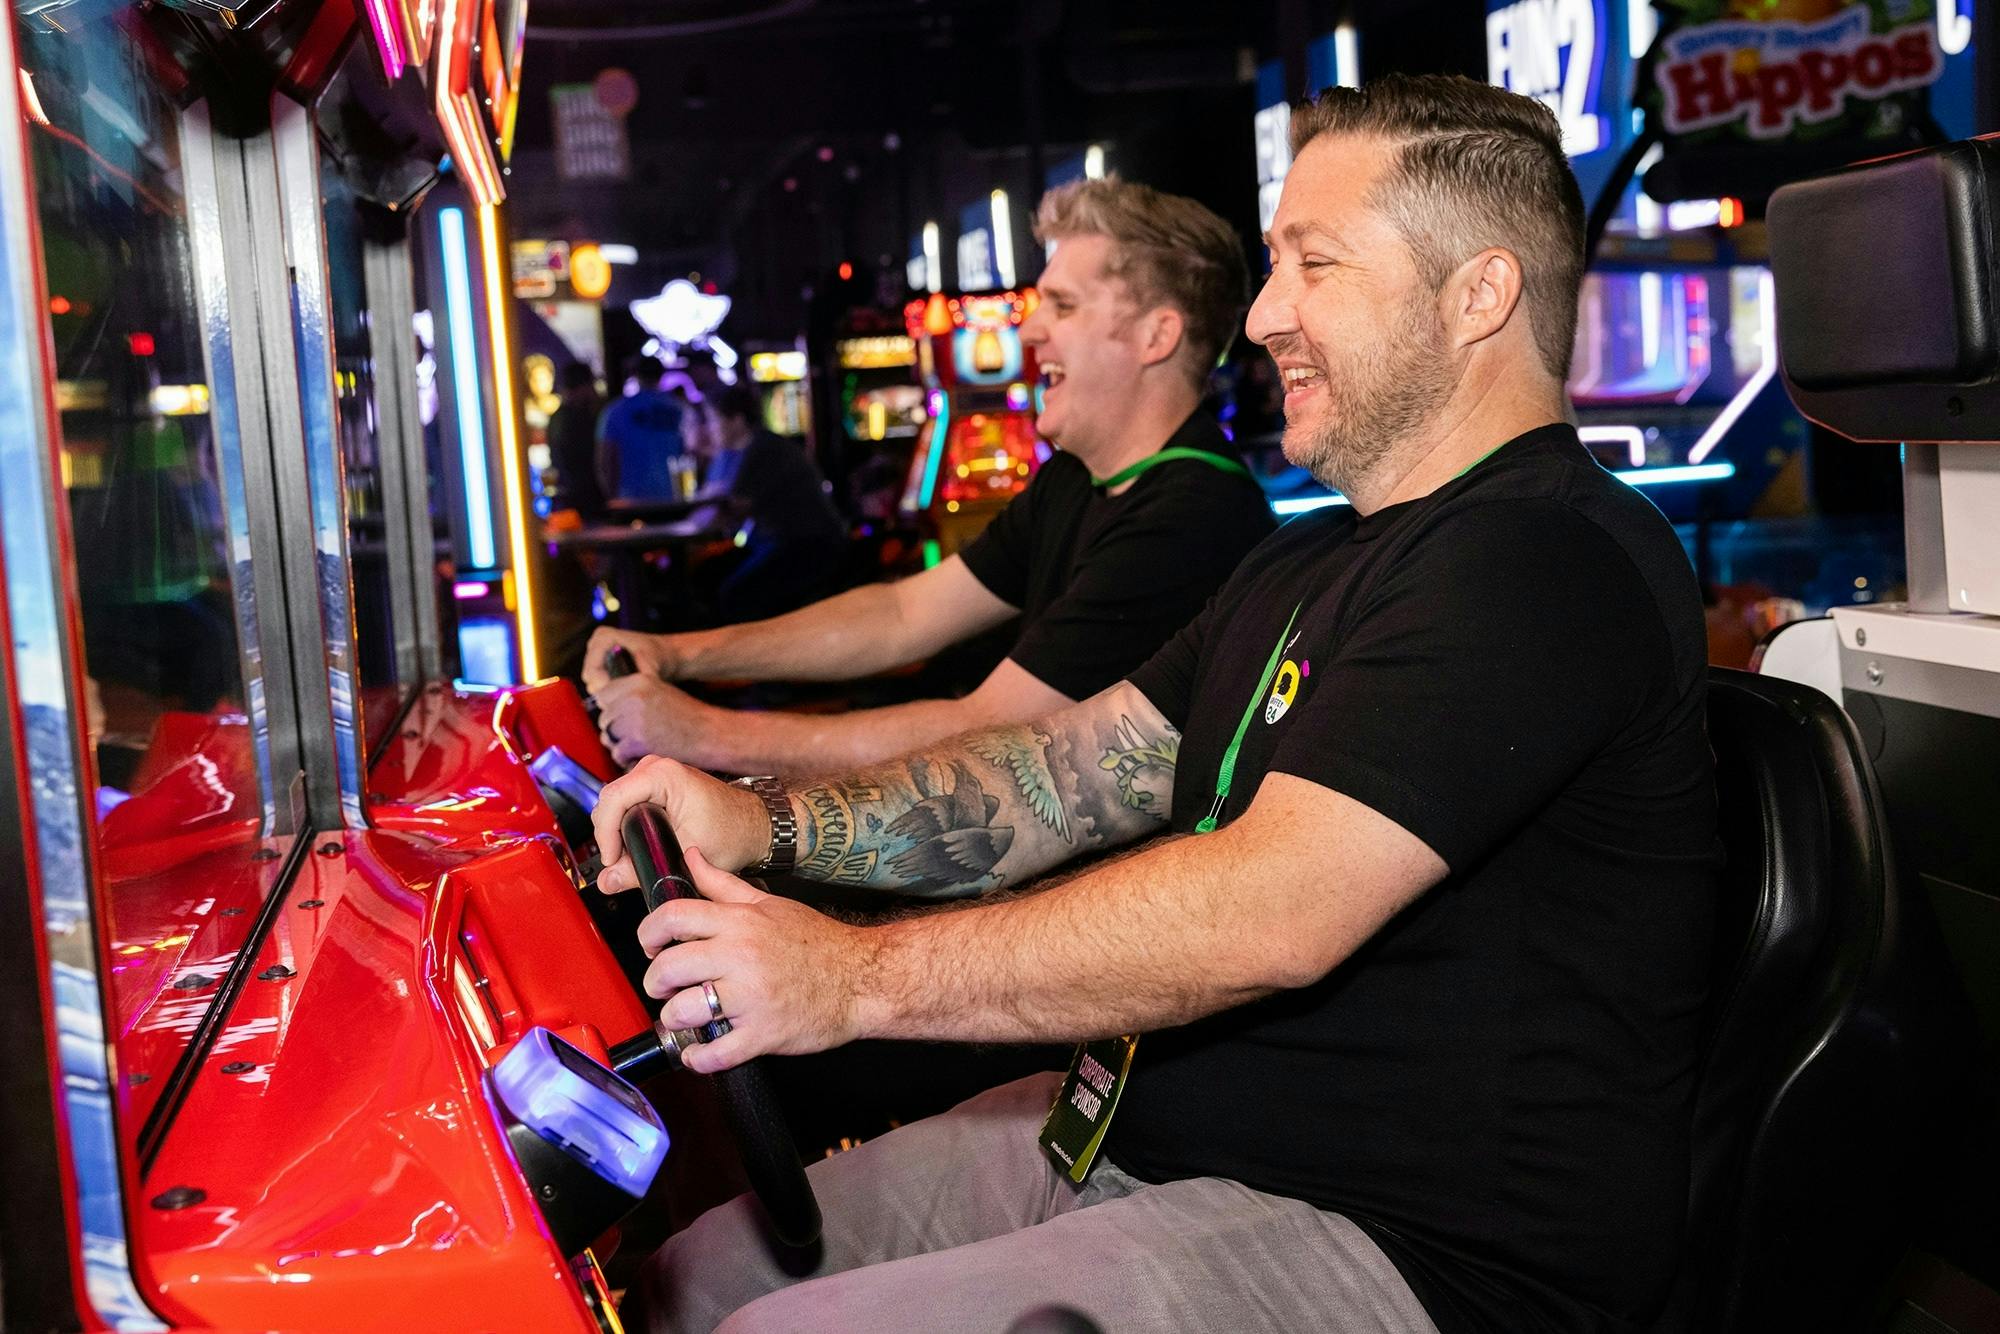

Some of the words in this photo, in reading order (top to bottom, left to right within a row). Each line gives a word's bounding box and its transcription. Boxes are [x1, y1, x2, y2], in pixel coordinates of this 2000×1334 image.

[1665, 29, 1937, 129] Hippos
[1266, 706, 1277, 722] 24
[1078, 1053, 1116, 1099] CORPORATE
[1071, 1082, 1102, 1123] SPONSOR
